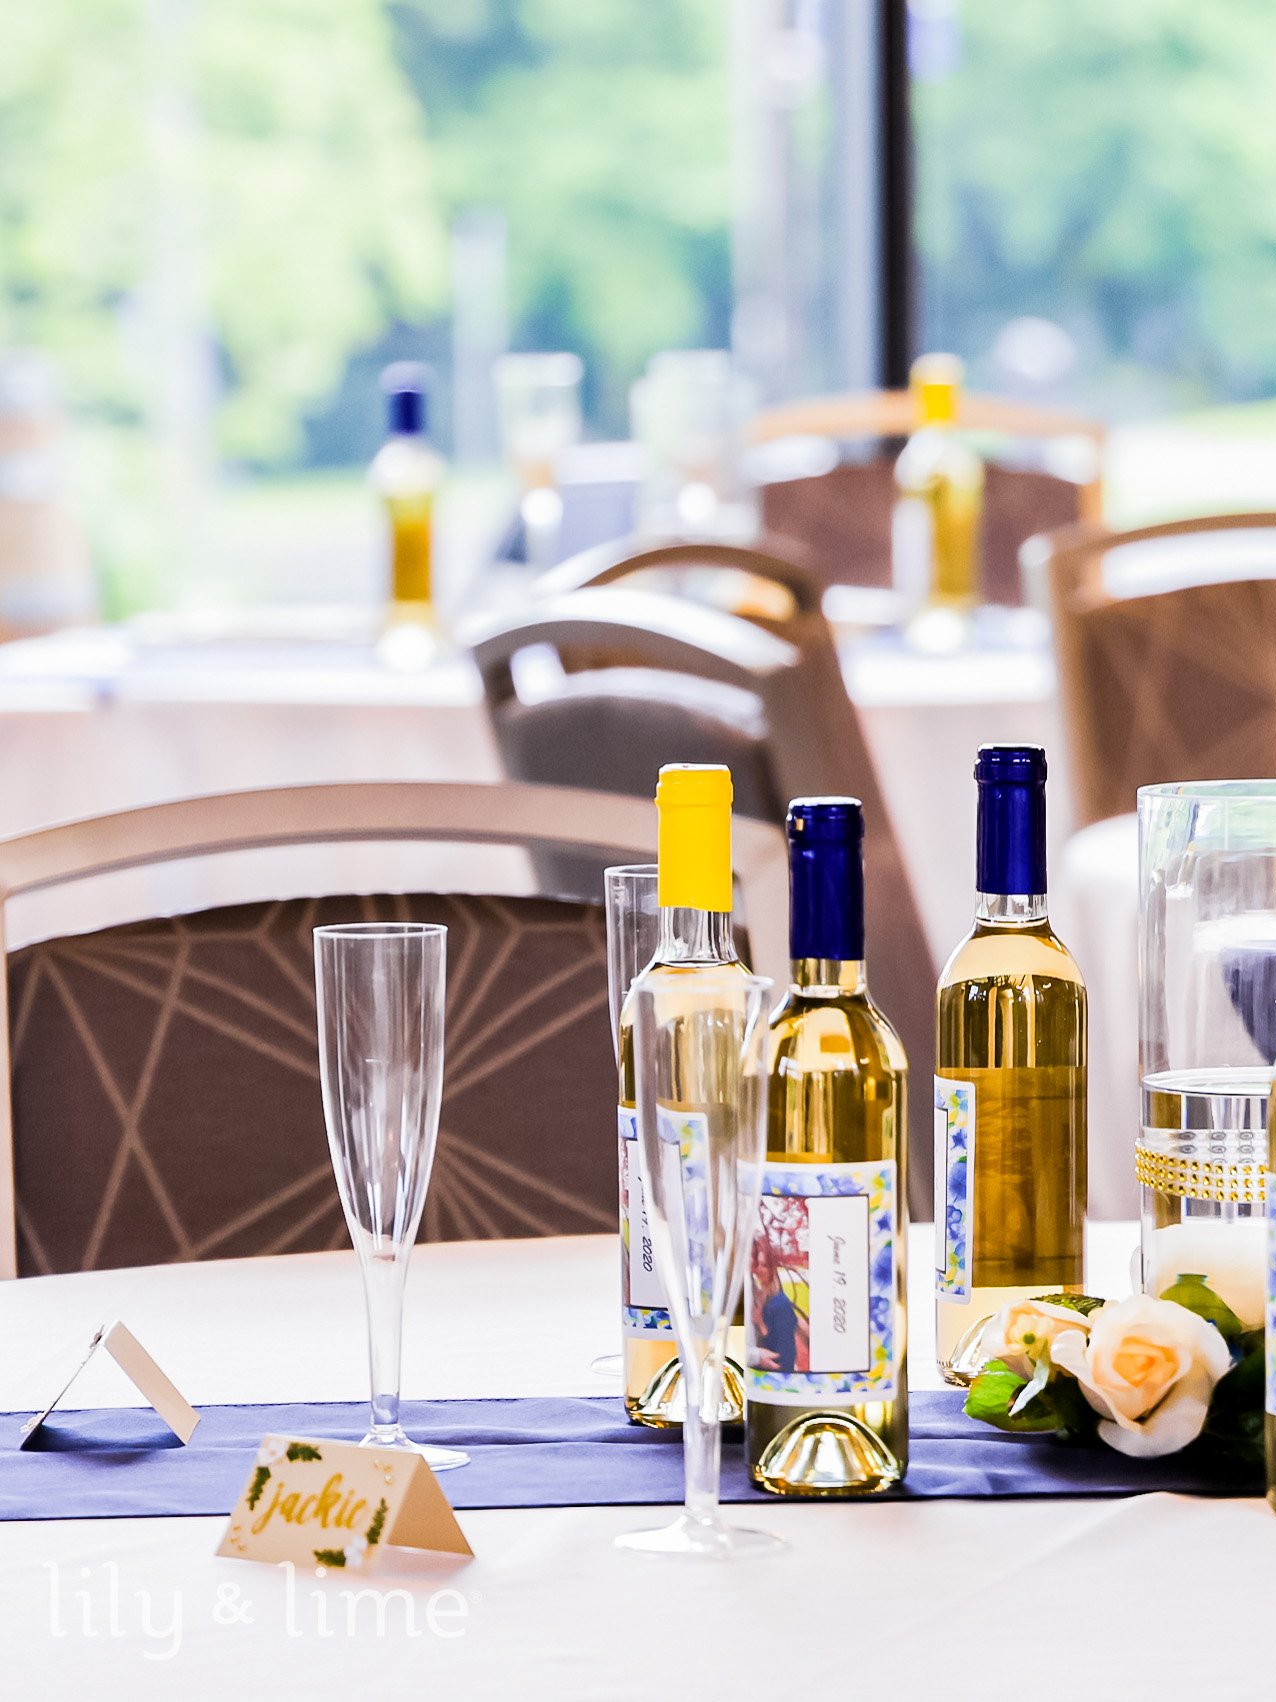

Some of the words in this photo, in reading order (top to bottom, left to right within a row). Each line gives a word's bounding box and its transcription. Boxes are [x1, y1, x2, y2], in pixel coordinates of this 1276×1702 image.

[641, 1236, 654, 1273] 2020
[826, 1234, 846, 1264] June
[833, 1297, 846, 1334] 2020
